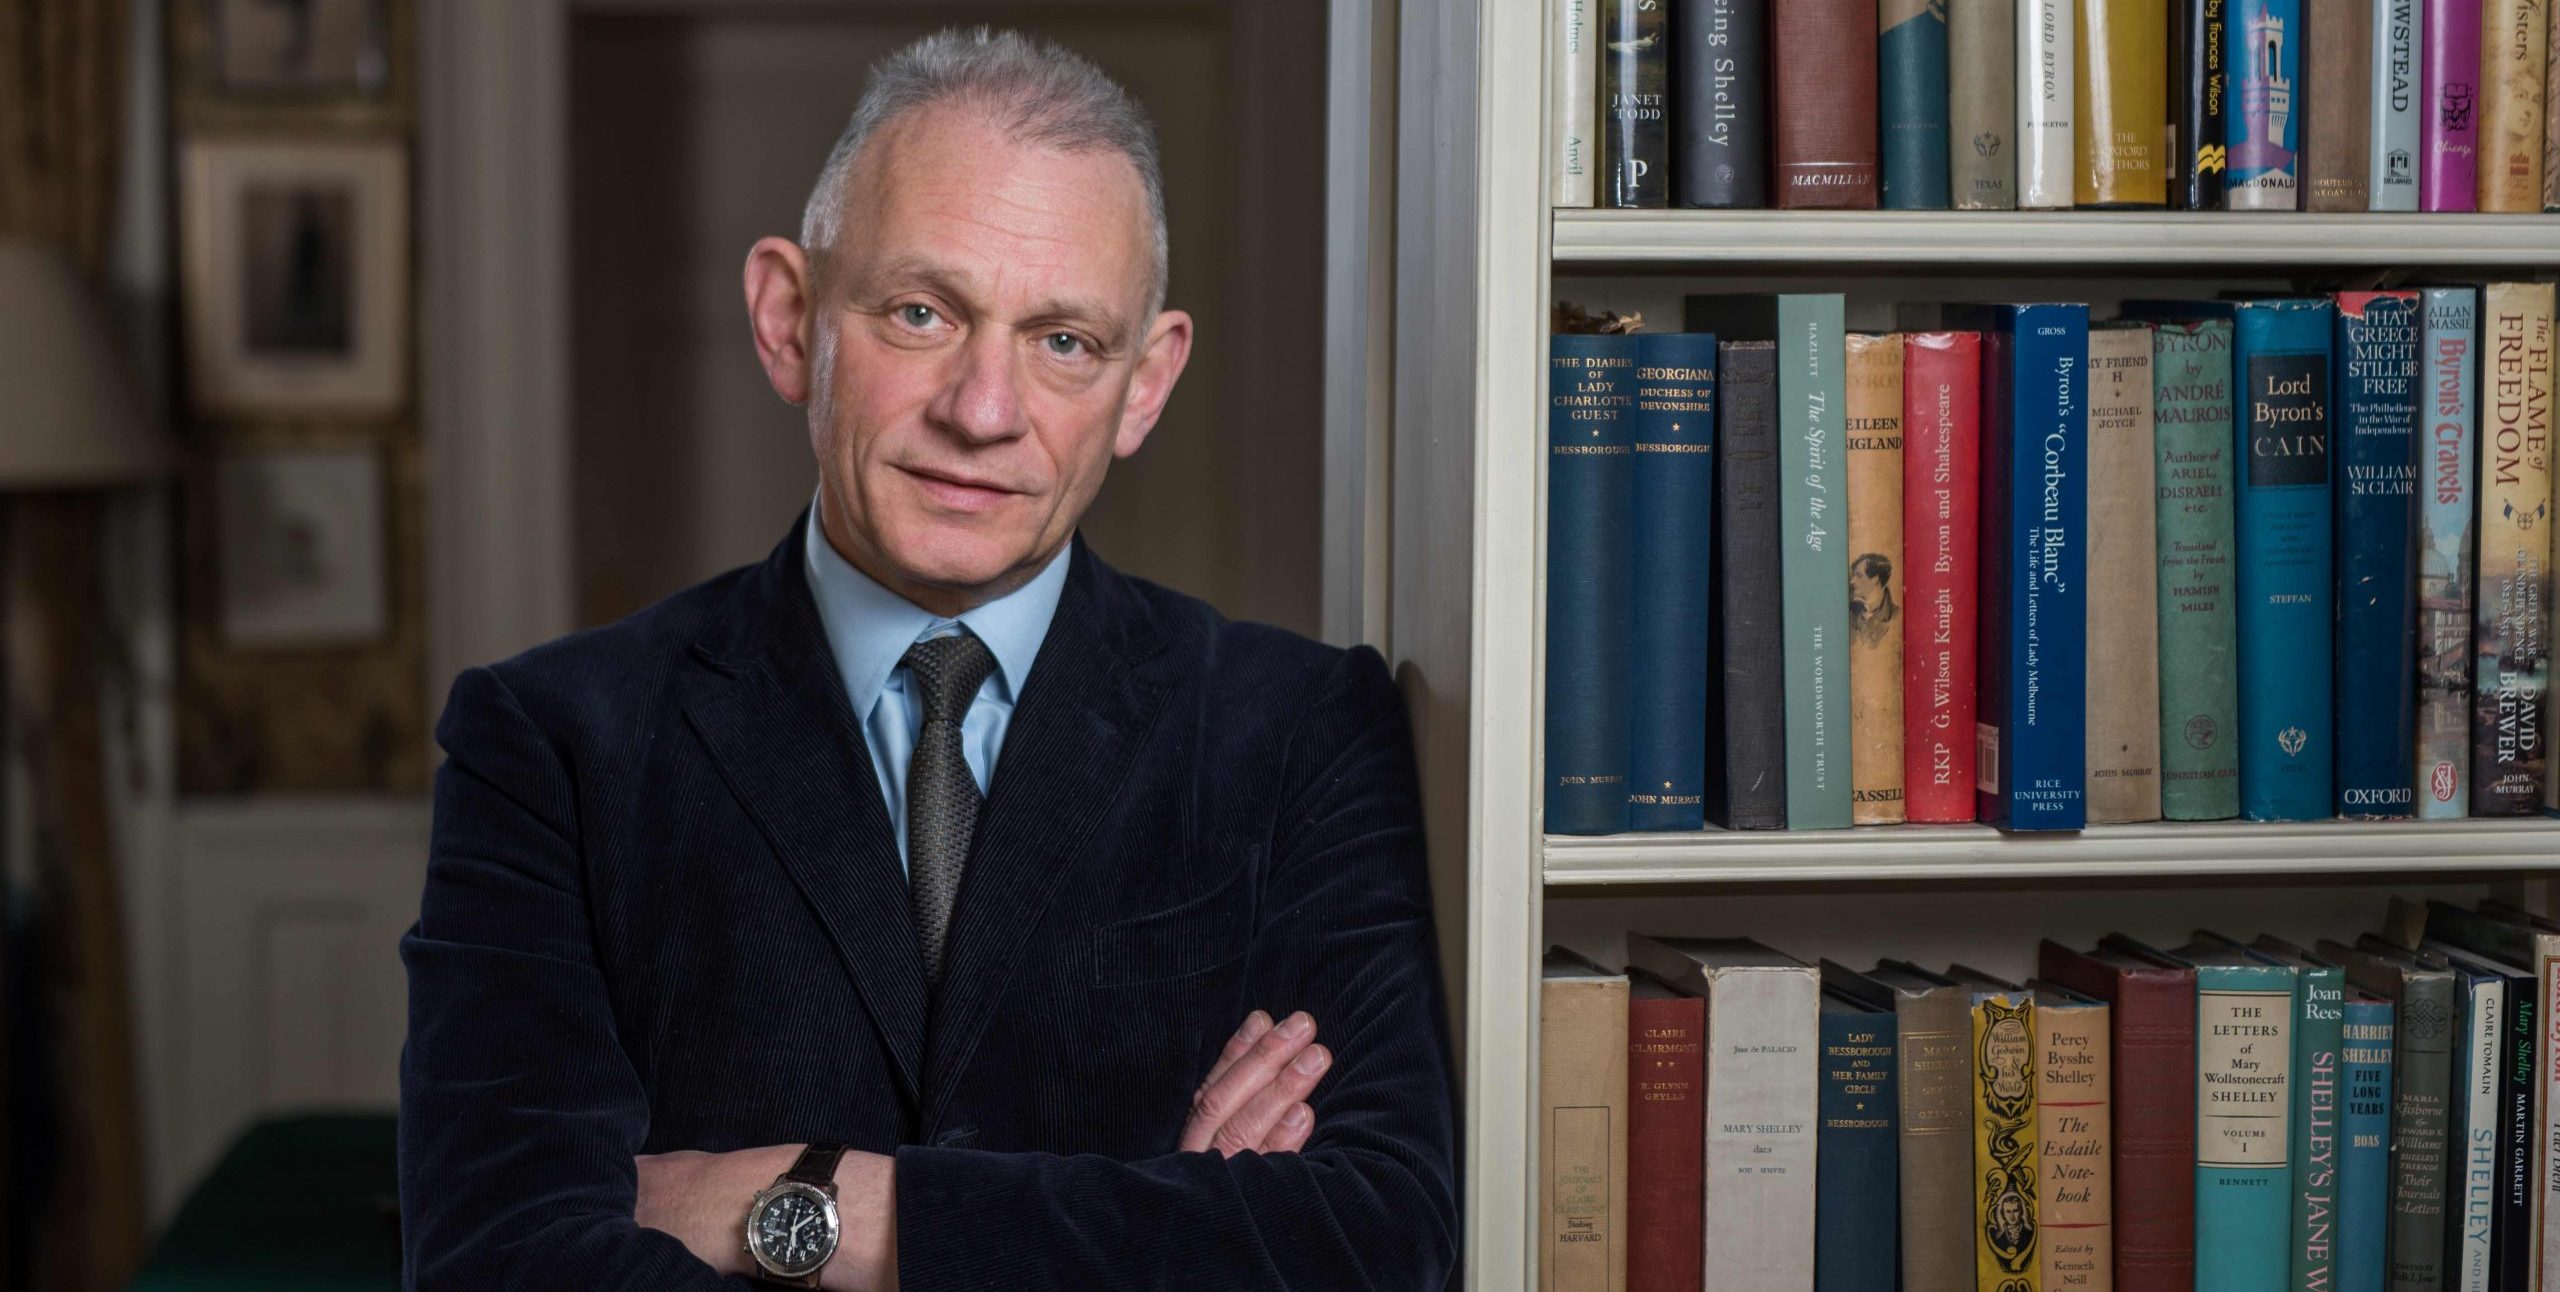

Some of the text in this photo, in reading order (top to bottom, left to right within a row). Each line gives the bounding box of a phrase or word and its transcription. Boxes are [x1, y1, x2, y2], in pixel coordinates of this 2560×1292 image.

[2043, 50, 2055, 103] BYRON
[1612, 94, 1662, 108] JANET
[1708, 58, 1736, 146] Shelley
[2209, 74, 2222, 116] Wilson
[1614, 108, 1661, 120] TODD
[2115, 132, 2136, 143] THE
[1567, 136, 1583, 176] Anvil
[1791, 173, 1872, 187] MACMILLAN
[1975, 179, 2003, 190] TEXAS
[2229, 176, 2296, 189] MACDONALD
[2364, 309, 2410, 326] THAT
[2428, 305, 2472, 319] ALLAN
[2038, 327, 2066, 336] GROSS
[2427, 318, 2472, 331] MASSIE
[2154, 332, 2227, 353] BYRON
[2351, 327, 2419, 343] GREECE
[1808, 322, 1818, 378] HAZLITT
[2355, 344, 2416, 361] MIGHT
[1553, 357, 1634, 369] THE DIARIES
[2106, 356, 2149, 369] FRIEND
[2349, 361, 2418, 377] STILL BE
[1588, 370, 1605, 379] OF
[1636, 366, 1715, 382] GEORGIANA
[2112, 371, 2123, 383] H
[1578, 381, 1615, 393] LADY
[2054, 356, 2075, 417] Byron's
[2159, 378, 2226, 403] ANDRÉ
[2266, 373, 2312, 396] Lord
[2363, 379, 2408, 395] FREE
[1553, 395, 1633, 407] CHARLOTTE
[1640, 387, 1712, 399] DUCHESS OF
[2496, 312, 2524, 487] FREEDOM
[2527, 313, 2549, 474] The FLAME of
[1640, 401, 1711, 412] DEVONSHIRE
[1808, 391, 1825, 424] The
[2092, 406, 2143, 417] MICHAEL
[1571, 409, 1619, 421] GUEST
[2154, 406, 2231, 425] MAUROIS
[2254, 401, 2325, 429] Byron's
[2098, 418, 2137, 429] JOYCE
[1934, 384, 1953, 484] Shakespeare
[1804, 426, 1826, 473] Spirit
[2254, 434, 2326, 457] CAIN
[2348, 465, 2417, 480] WILLIAM
[1809, 498, 1827, 520] the
[1934, 489, 1951, 520] and
[1805, 522, 1827, 552] Age
[2029, 527, 2040, 543] The
[1934, 526, 1953, 575] Byron
[2029, 545, 2040, 569] Life
[2269, 594, 2313, 605] STEFFAN
[1934, 588, 1953, 644] Knight
[2028, 592, 2040, 627] Letters
[2026, 642, 2039, 668] Lady
[2028, 669, 2039, 727] Melbourne
[1813, 625, 1825, 791] THE WORDSWORTH TRUST
[2498, 671, 2518, 765] BREWER
[2518, 685, 2536, 752] DAVID
[1934, 743, 1951, 786] RKP
[1560, 776, 1586, 787] JOHN
[2035, 779, 2062, 789] RICE
[2503, 773, 2529, 784] JOHN
[2014, 789, 2082, 801] UNIVERSITY
[2345, 788, 2412, 805] OXFORD
[2495, 784, 2535, 795] MURRAY
[1628, 794, 1657, 804] JOHN
[2032, 802, 2065, 812] PRESS
[2306, 983, 2343, 1003] Joan
[2231, 1006, 2263, 1019] THE
[2304, 1002, 2343, 1021] Rees
[1847, 1032, 1876, 1044] LADY
[2213, 1023, 2279, 1037] LETTERS
[2051, 1031, 2091, 1051] Percy
[2480, 997, 2497, 1096] CLAIRE TOMALIN
[2513, 999, 2535, 1086] Mary Shelley
[2240, 1043, 2253, 1056] of
[1851, 1059, 1871, 1069] AND
[2047, 1050, 2095, 1069] Bysshe
[2230, 1057, 2261, 1073] Mary
[1832, 1070, 1889, 1081] HER FAMILY
[2045, 1069, 2096, 1088] Shelley
[2204, 1072, 2286, 1086] Wollstonecraft
[2355, 1070, 2382, 1083] FIVE
[1844, 1084, 1877, 1095] CIRCLE
[2211, 1091, 2278, 1103] SHELLEY
[2352, 1085, 2382, 1099] LONG
[1723, 1123, 1803, 1134] MARY SHELLEY
[2058, 1116, 2090, 1134] The
[2223, 1128, 2267, 1139] VOLUME
[2353, 1134, 2381, 1149] BOAS
[2042, 1139, 2102, 1158] Esdaile
[2512, 1092, 2526, 1207] MARTIN GARRETT
[2052, 1163, 2095, 1181] Note-
[2218, 1178, 2270, 1187] BENNETT
[2055, 1186, 2092, 1203] book
[2468, 1127, 2494, 1277] SHELLEY AND
[2304, 1190, 2332, 1262] JANE
[1559, 1232, 1603, 1243] HARVARD
[2053, 1260, 2096, 1271] Kenneth
[2062, 1274, 2088, 1286] Neill
